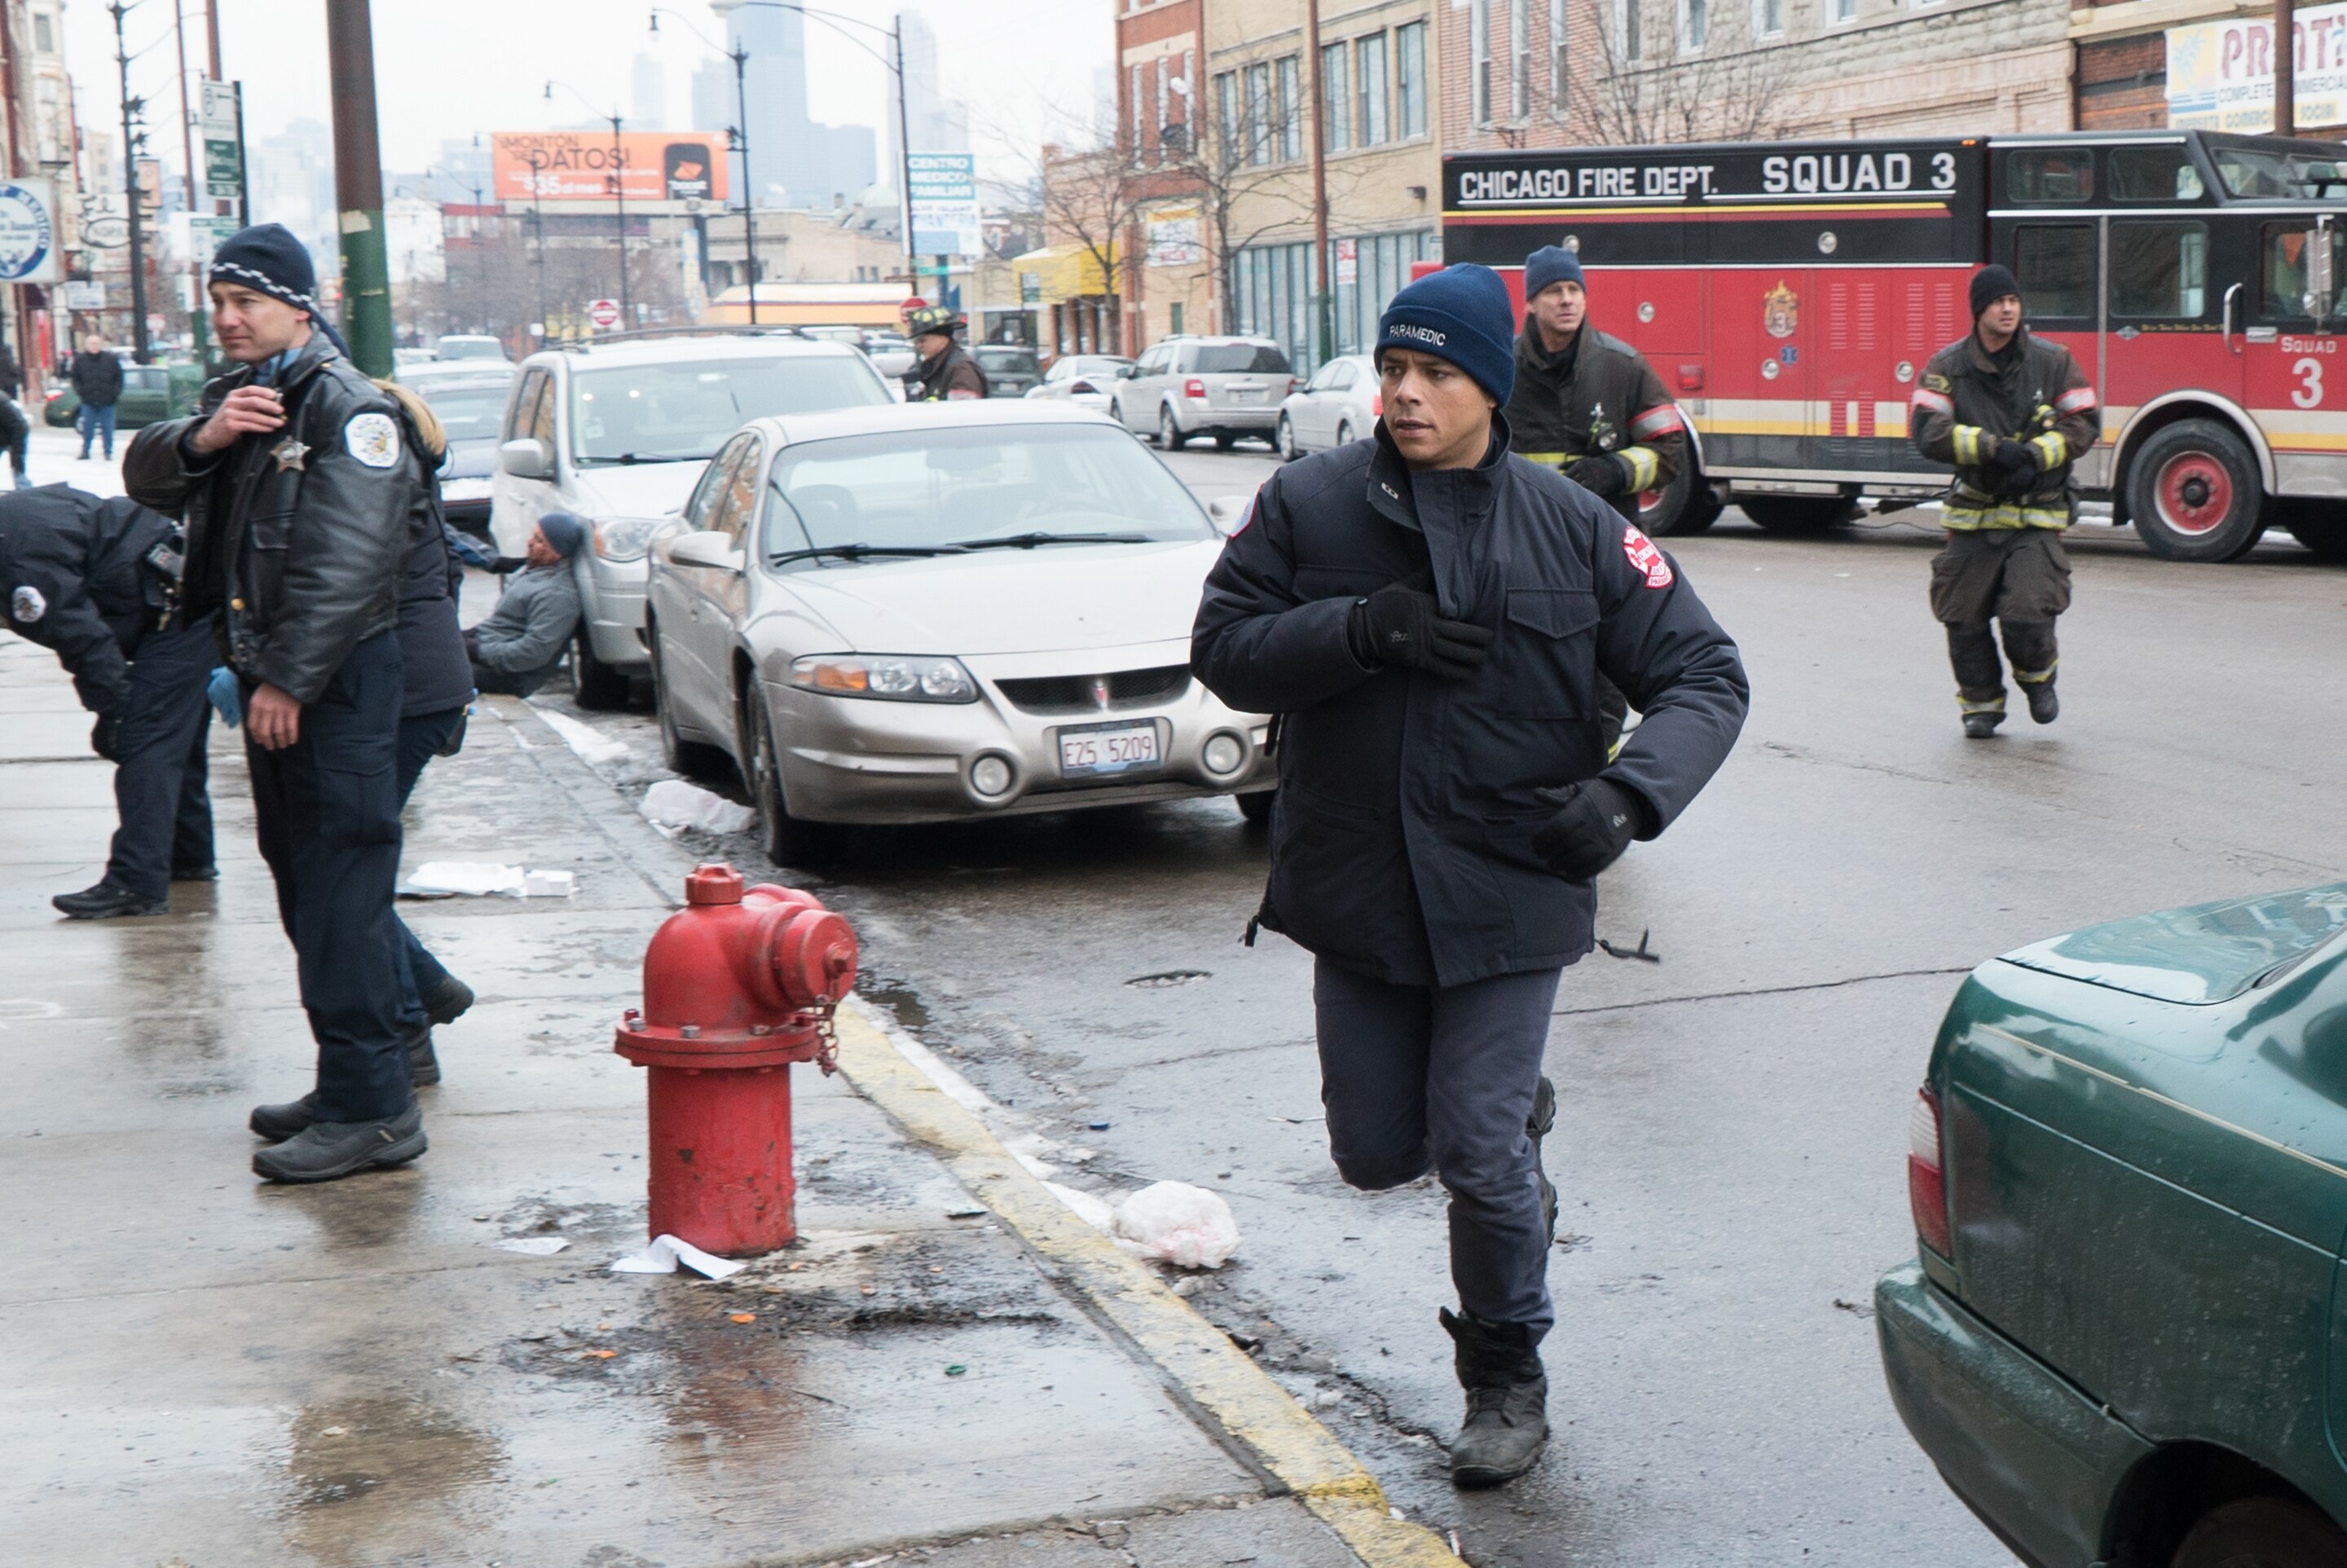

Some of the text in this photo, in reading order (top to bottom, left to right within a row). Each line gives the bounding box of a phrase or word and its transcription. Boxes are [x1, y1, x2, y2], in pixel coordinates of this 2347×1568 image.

[2218, 82, 2274, 104] COMPLETE
[908, 156, 969, 170] CENTRO
[1762, 152, 1957, 193] SQUAD 3
[909, 184, 973, 197] FAMILIAR
[1460, 165, 1719, 200] CHICAGO FIRE DEPT.
[1389, 324, 1447, 346] PARAMEDIC
[2281, 336, 2337, 354] SQUAD
[2290, 357, 2324, 409] 3
[1064, 736, 1151, 767] E25 5209
